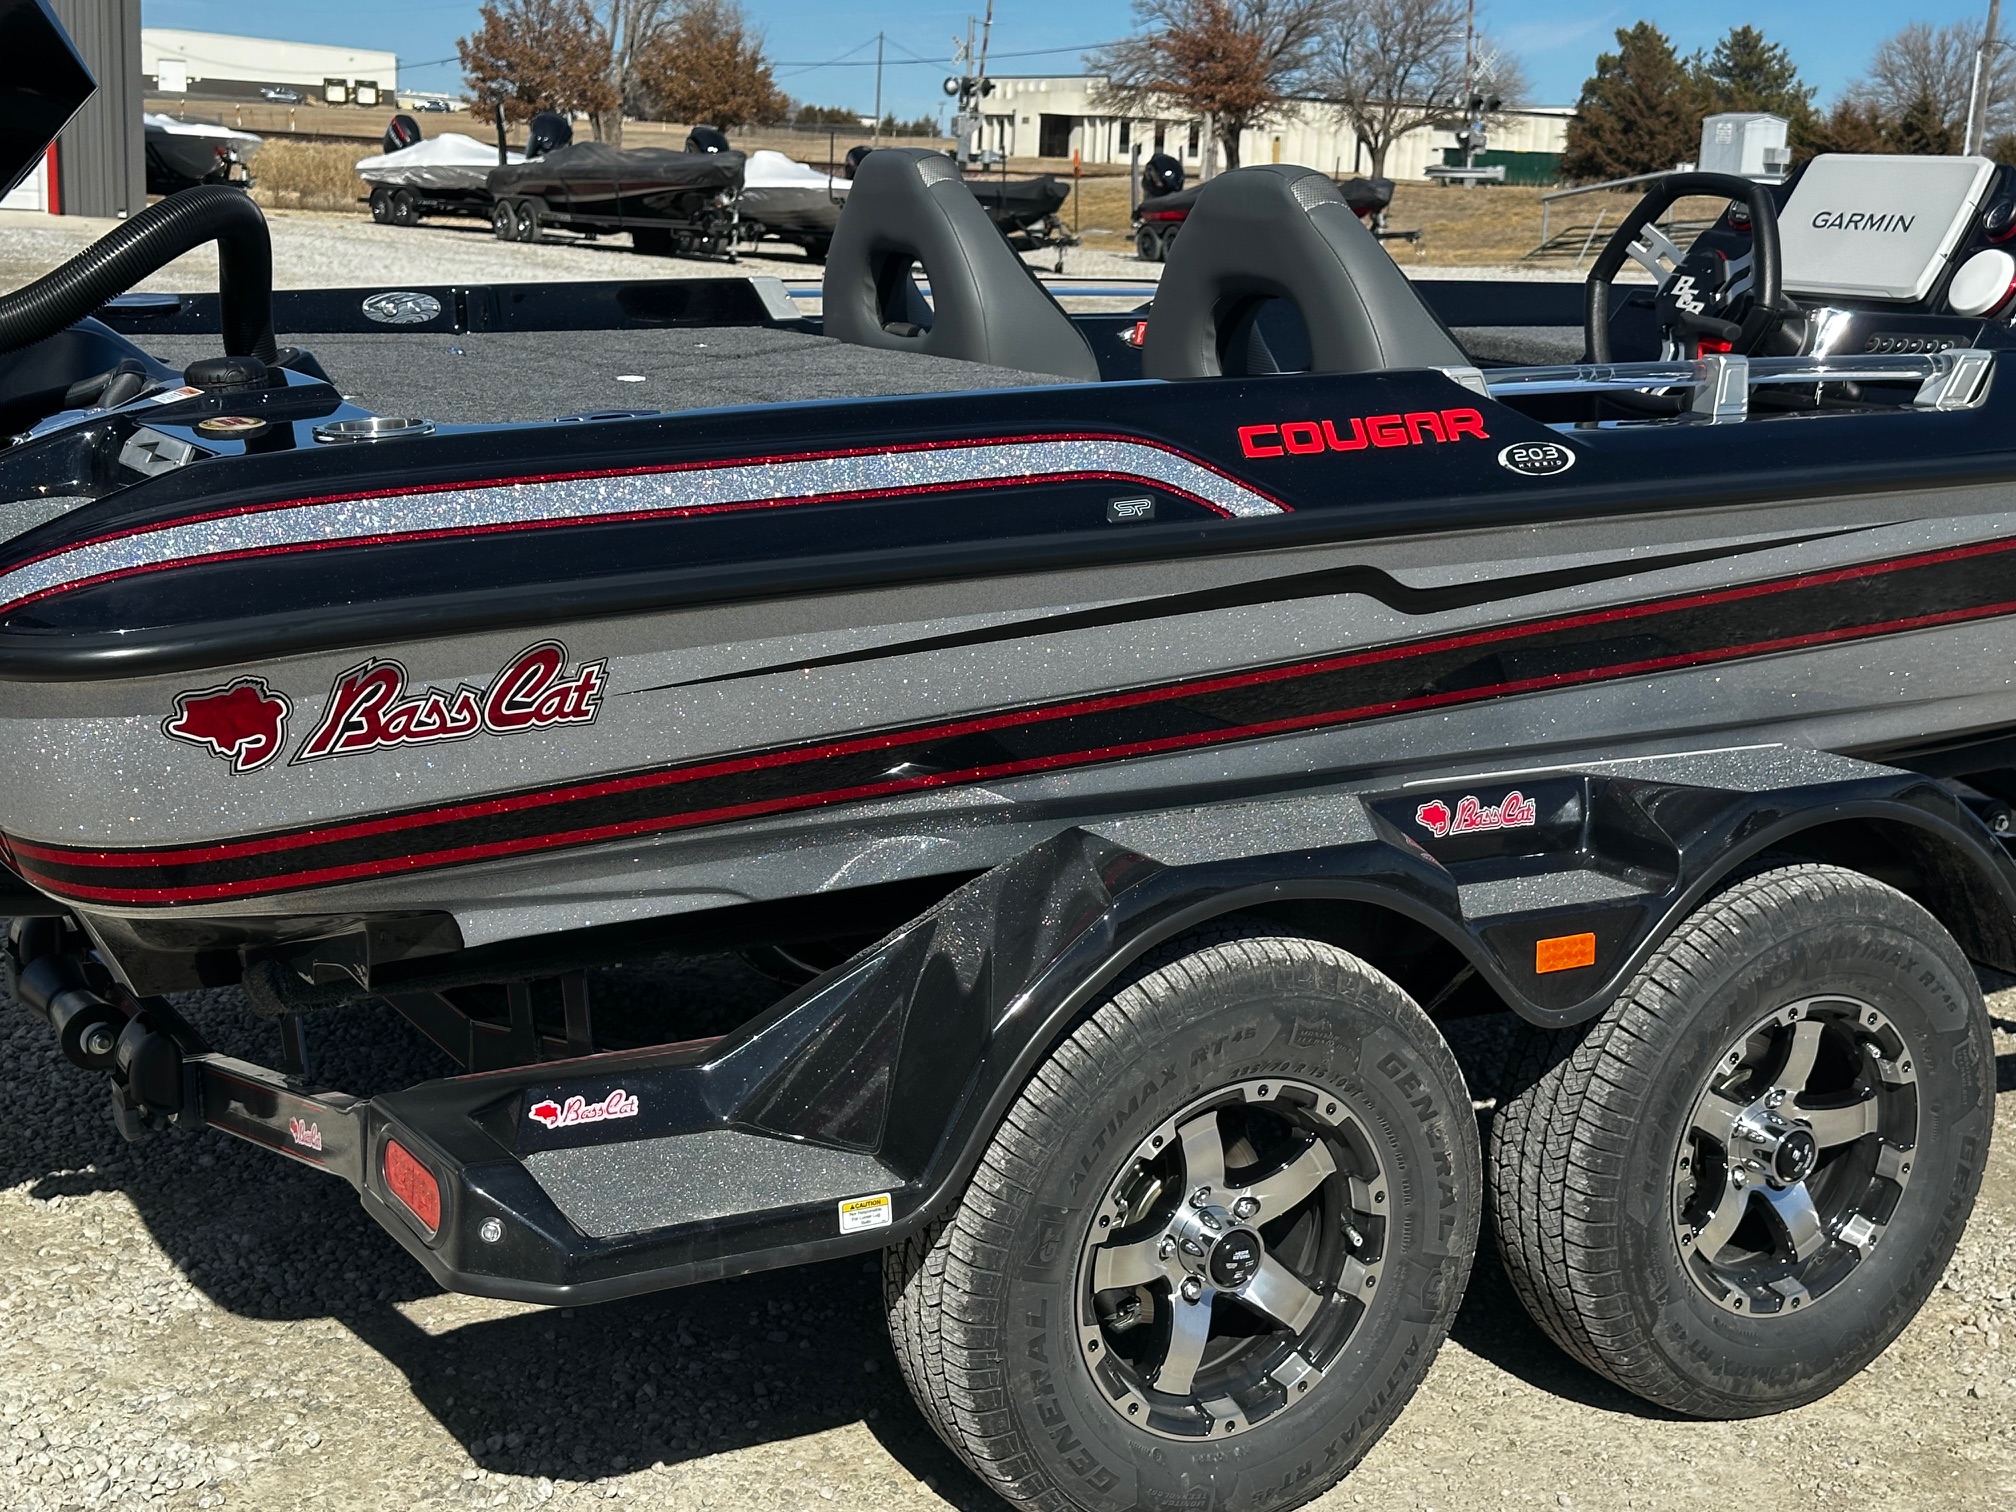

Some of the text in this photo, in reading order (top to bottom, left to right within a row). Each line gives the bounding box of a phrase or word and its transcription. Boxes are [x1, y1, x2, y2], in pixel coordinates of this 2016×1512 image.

[1811, 211, 1916, 233] GARMIN
[1237, 407, 1491, 459] COUGAR
[1512, 446, 1559, 462] 203
[1518, 460, 1562, 468] HYBRID
[1113, 498, 1152, 517] SP
[1069, 1061, 1178, 1198] ALTIMAX
[1376, 1051, 1457, 1242] GENERAL
[855, 1199, 881, 1209] CAUTION
[1025, 1298, 1122, 1496] GENERAL
[1323, 1334, 1421, 1463] ALTIMAX
